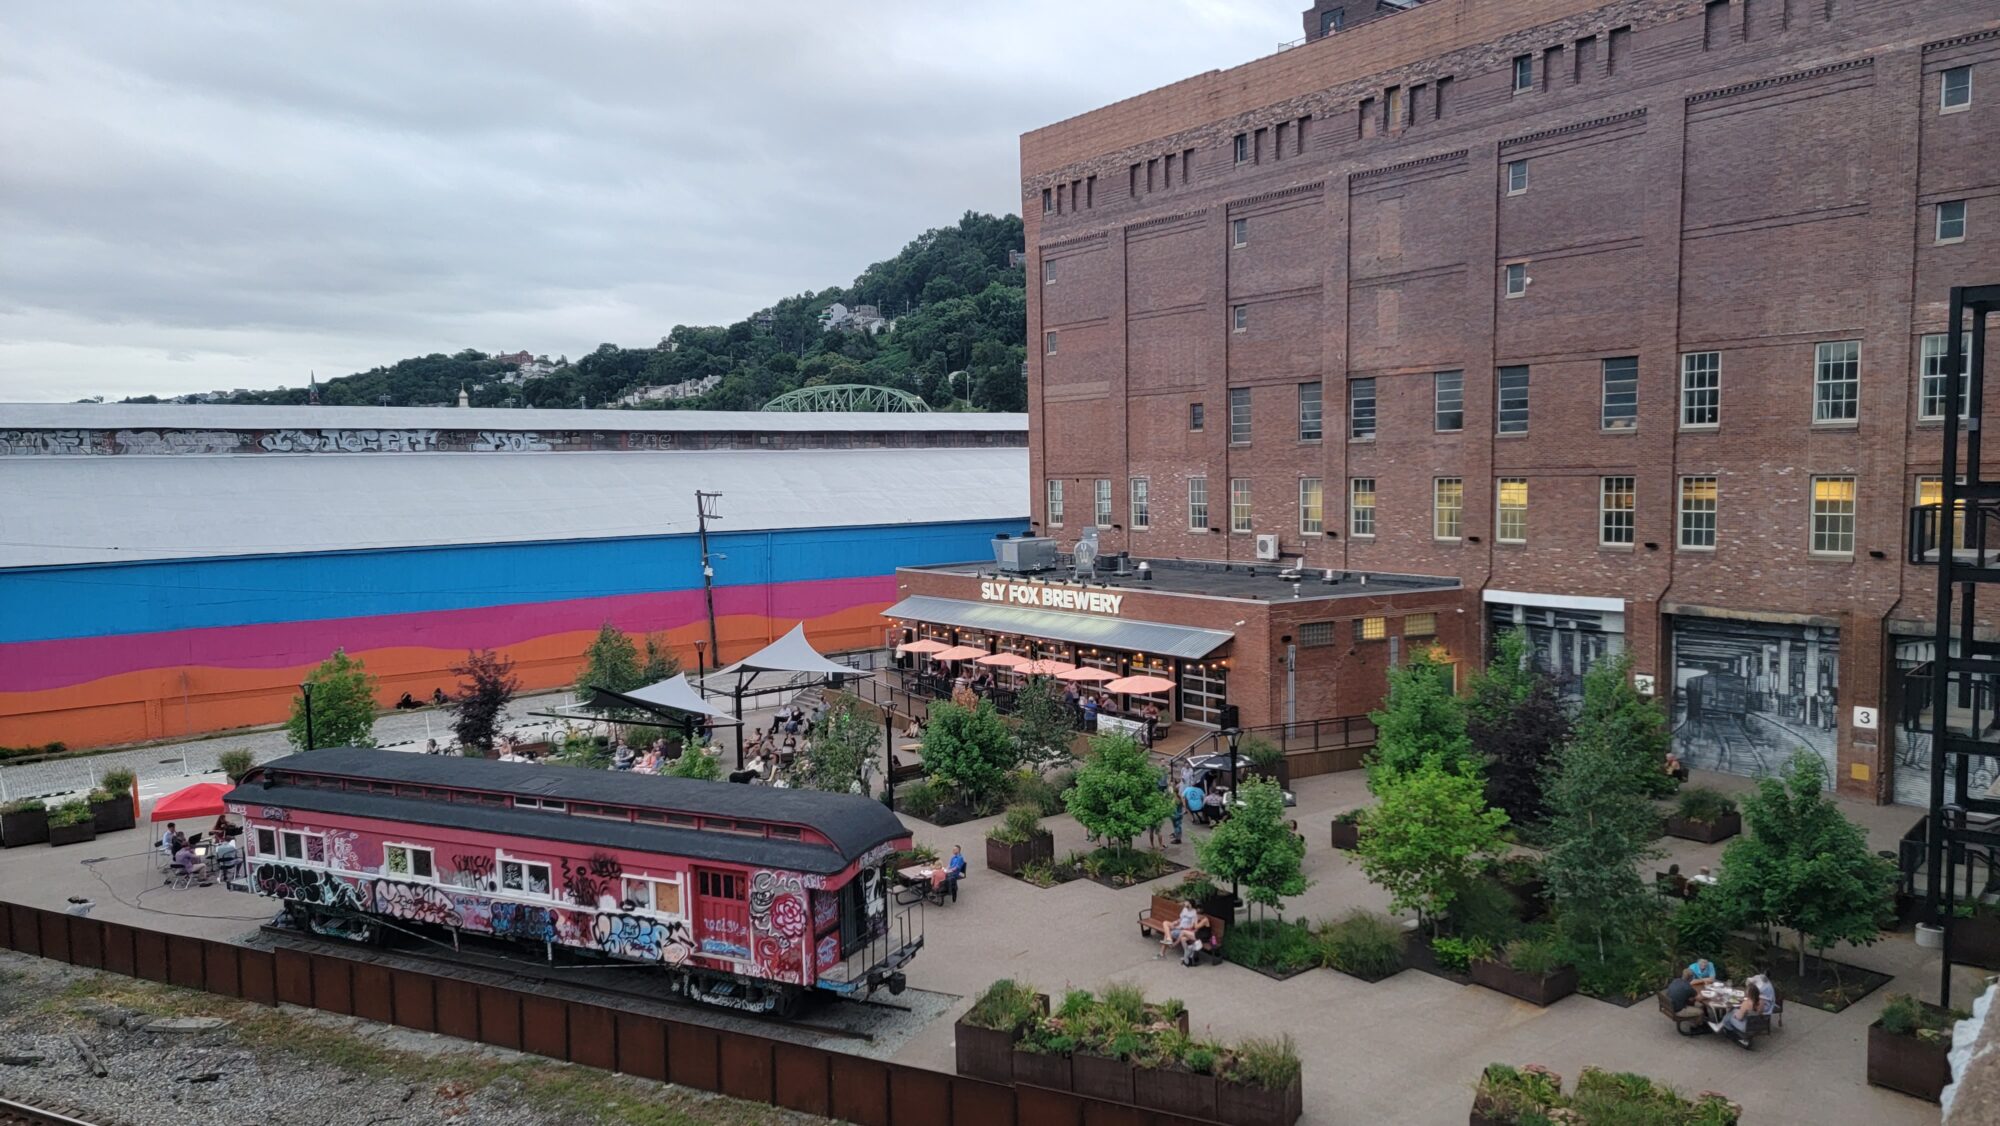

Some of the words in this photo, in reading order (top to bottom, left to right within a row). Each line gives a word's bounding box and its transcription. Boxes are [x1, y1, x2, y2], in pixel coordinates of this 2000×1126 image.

[981, 582, 1007, 601] SLY
[1008, 585, 1040, 605] FOX
[1042, 588, 1123, 614] BREWERY
[1860, 711, 1871, 724] 3
